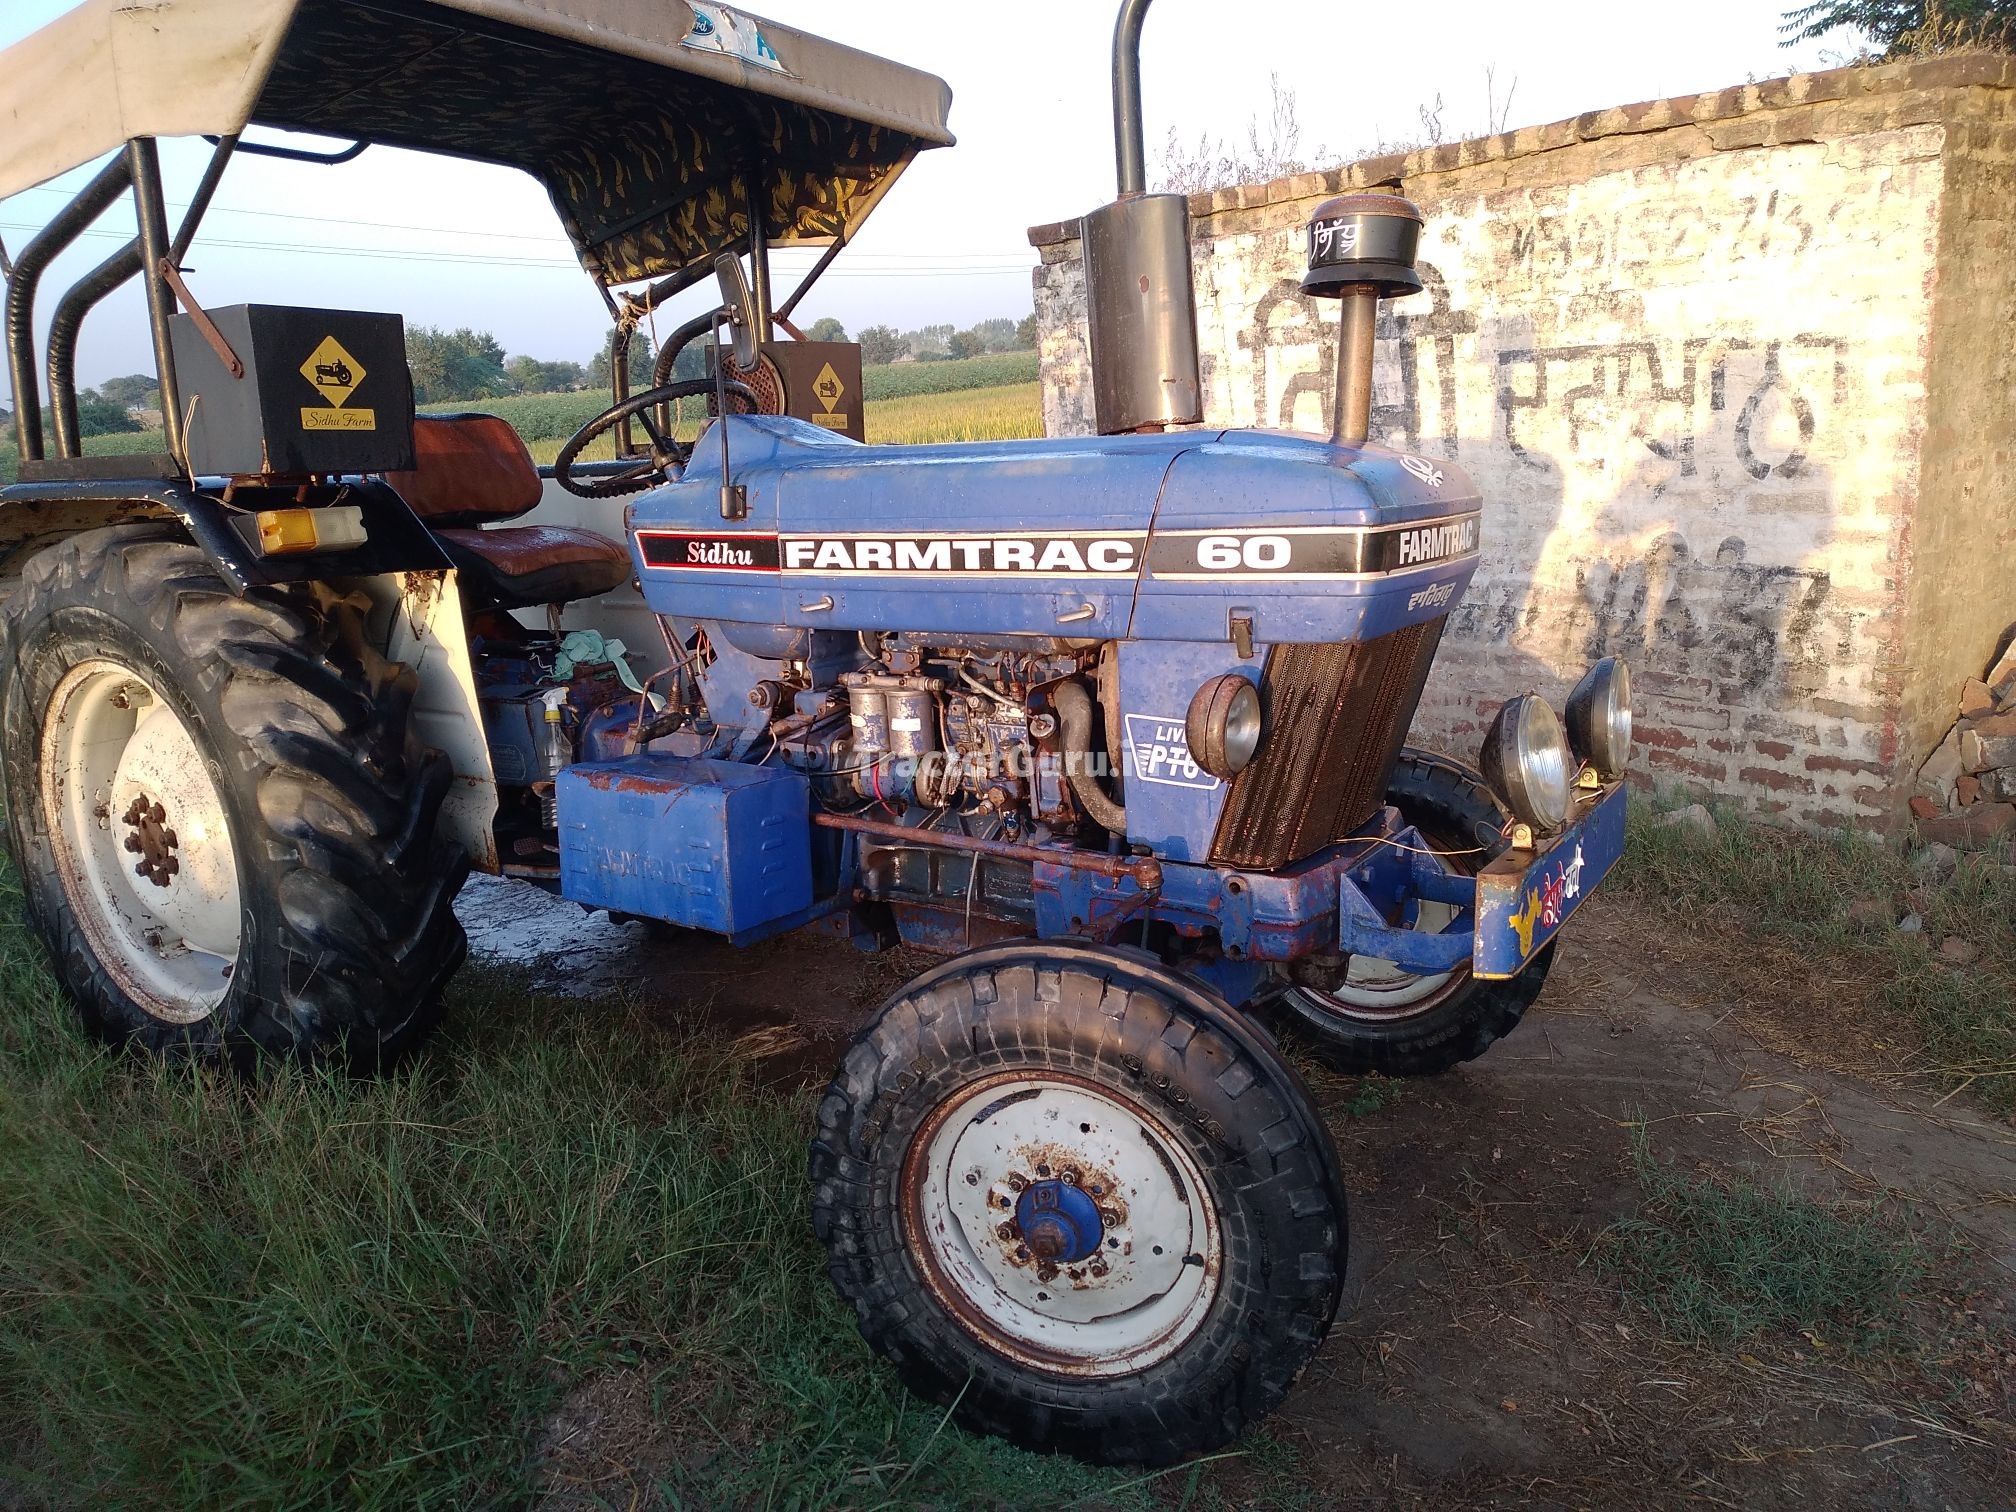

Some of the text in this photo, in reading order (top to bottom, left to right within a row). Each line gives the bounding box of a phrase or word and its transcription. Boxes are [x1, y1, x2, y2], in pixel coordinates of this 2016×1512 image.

[305, 412, 372, 427] Sidhu Farm
[687, 536, 1292, 571] Sidhu FARMTRAC 60
[1399, 519, 1473, 565] FARMTRAC
